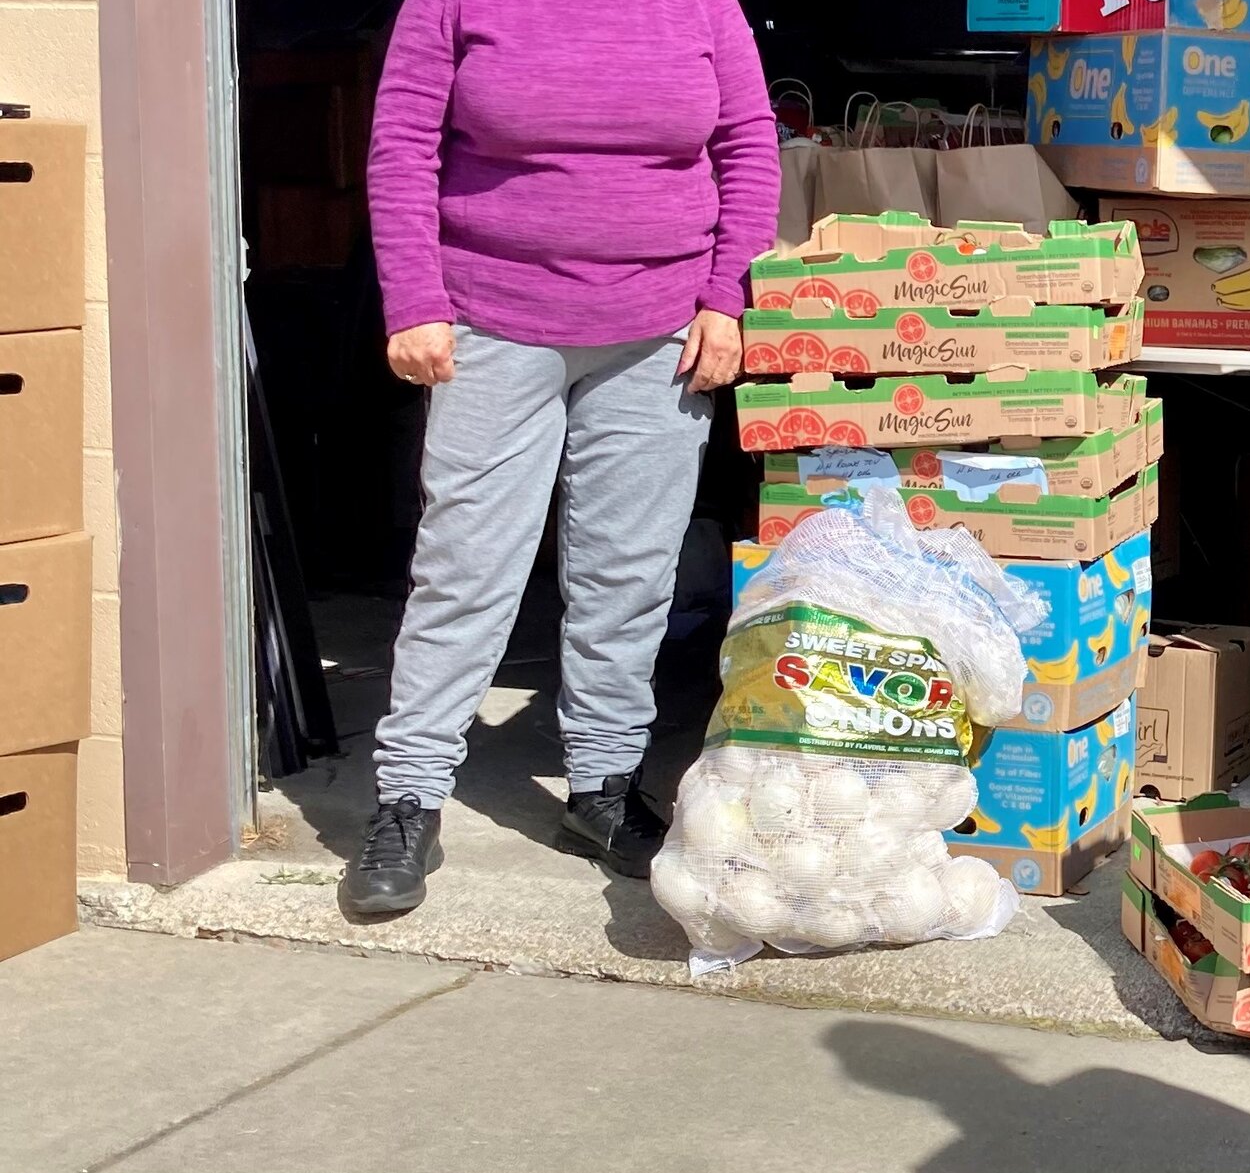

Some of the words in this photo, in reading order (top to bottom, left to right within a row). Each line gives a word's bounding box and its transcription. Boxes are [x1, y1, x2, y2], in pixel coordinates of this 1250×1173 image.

[1182, 45, 1237, 77] One
[1069, 58, 1111, 100] One
[1136, 219, 1171, 238] ole
[894, 274, 990, 305] MagicSun
[1144, 317, 1169, 328] MIUM
[1172, 318, 1218, 329] BANANAS
[882, 337, 978, 365] MagicSun
[879, 407, 974, 436] MagicSun
[1077, 572, 1104, 603] One
[785, 631, 883, 661] SWEET
[805, 702, 957, 739] ONIONS
[798, 736, 845, 748] DISTRIBUTED
[855, 742, 888, 752] FLAVORS,
[1002, 744, 1023, 753] High
[1025, 744, 1034, 753] in
[1067, 736, 1089, 768] One
[1008, 768, 1018, 777] of
[1019, 768, 1042, 778] Fiber
[988, 782, 1013, 793] Good
[1014, 785, 1046, 795] Source
[993, 792, 1003, 800] of
[1003, 792, 1043, 803] Vitamins
